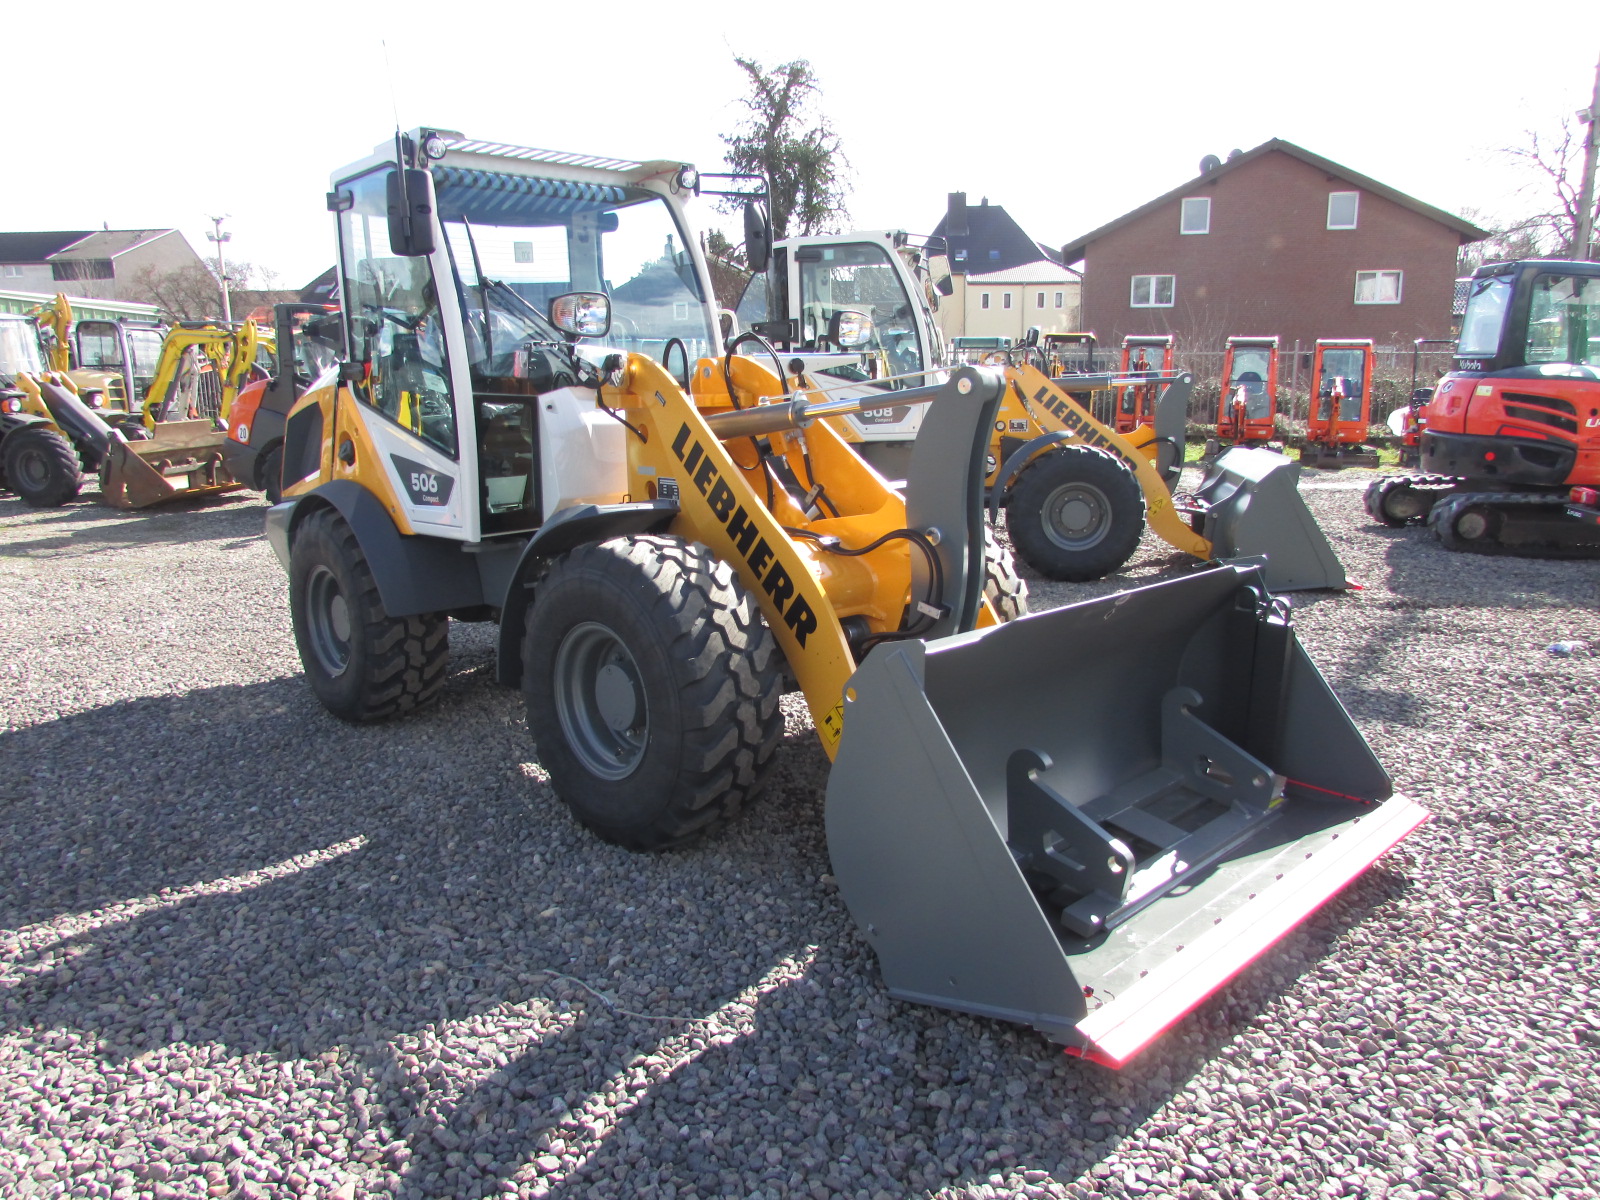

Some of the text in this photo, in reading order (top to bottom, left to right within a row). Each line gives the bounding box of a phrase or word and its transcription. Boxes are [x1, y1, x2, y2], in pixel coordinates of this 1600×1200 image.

[239, 427, 247, 439] 20
[411, 472, 438, 493] 506
[422, 495, 439, 503] Compact
[671, 421, 817, 650] LIEBHERR
